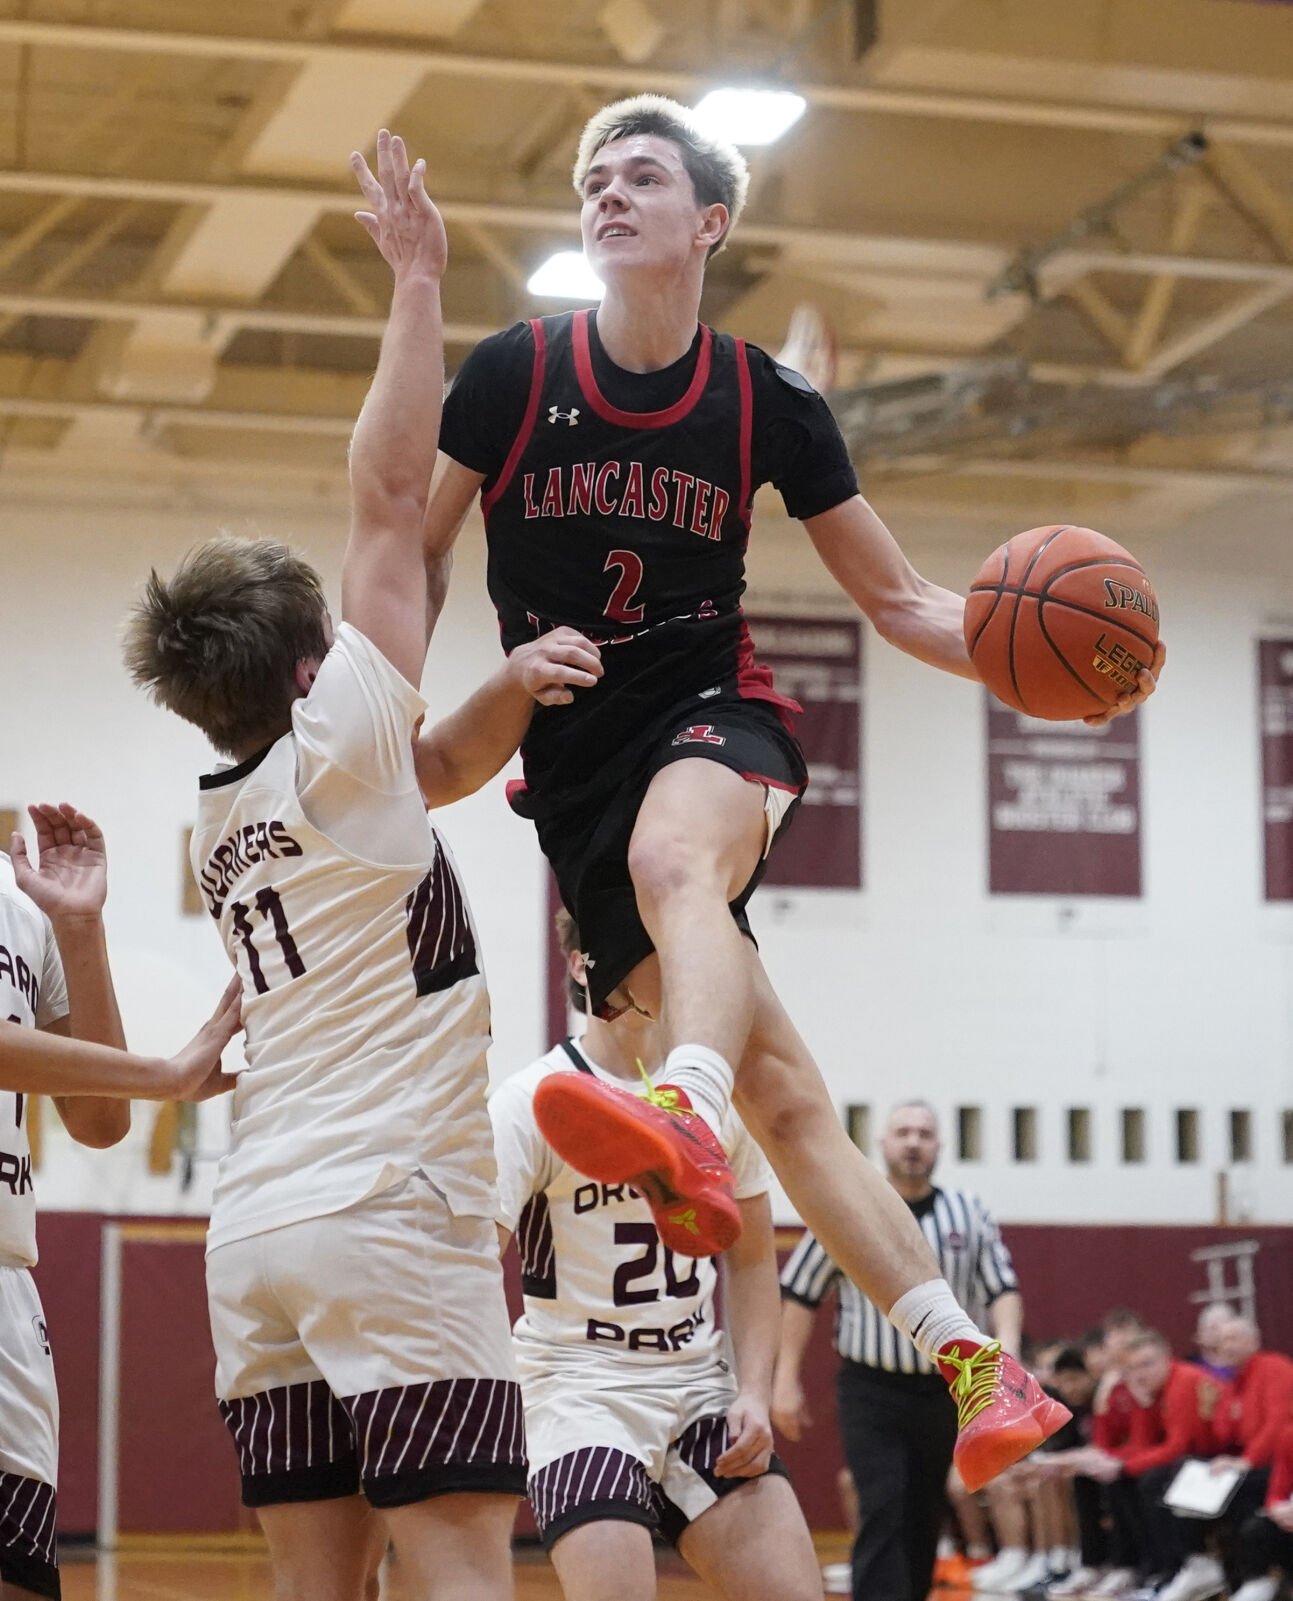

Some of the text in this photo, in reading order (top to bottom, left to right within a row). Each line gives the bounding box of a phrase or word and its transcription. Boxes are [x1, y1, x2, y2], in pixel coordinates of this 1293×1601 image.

[523, 461, 730, 541] LANCASTER
[602, 549, 646, 624] 2
[231, 886, 307, 994] 11
